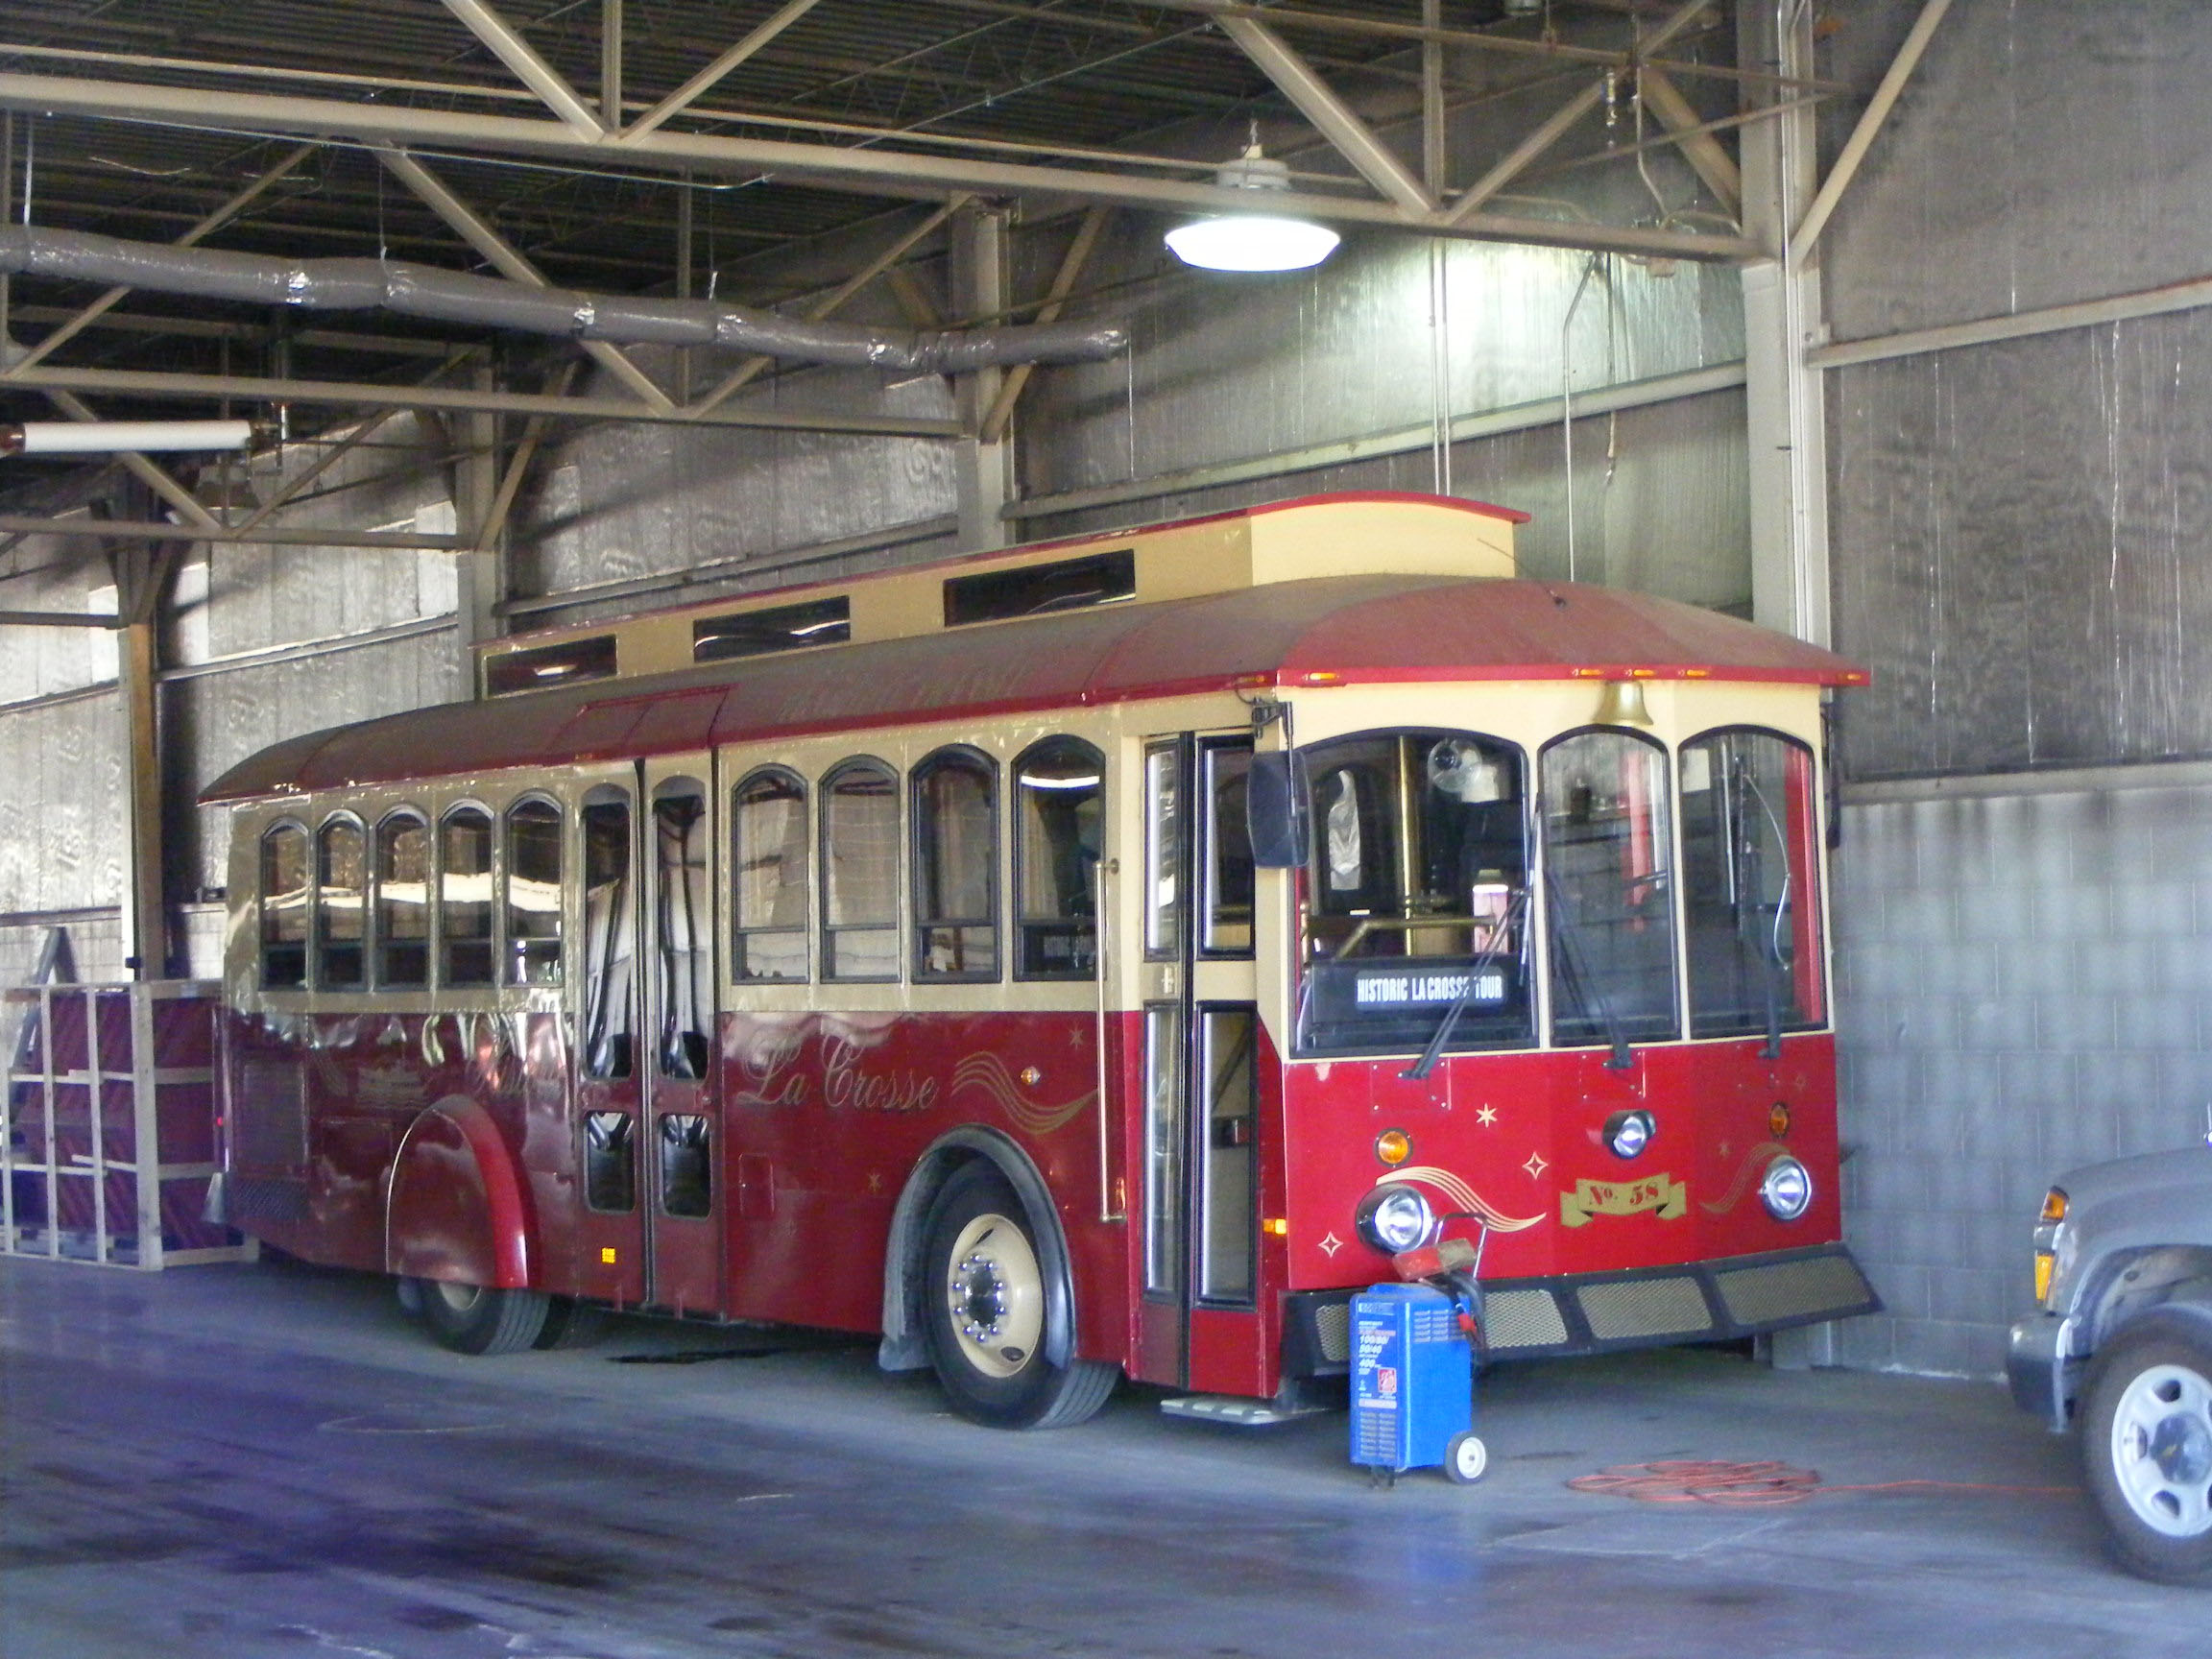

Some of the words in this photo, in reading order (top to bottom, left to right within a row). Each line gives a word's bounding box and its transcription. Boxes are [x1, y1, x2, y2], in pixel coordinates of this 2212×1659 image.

[1357, 976, 1408, 1002] HISTORIC
[1411, 976, 1427, 1001] LA
[1473, 975, 1503, 999] TOUR
[734, 1037, 810, 1106] La
[821, 1033, 940, 1109] Crosse
[1589, 1185, 1619, 1206] No.
[1629, 1181, 1660, 1206] 58
